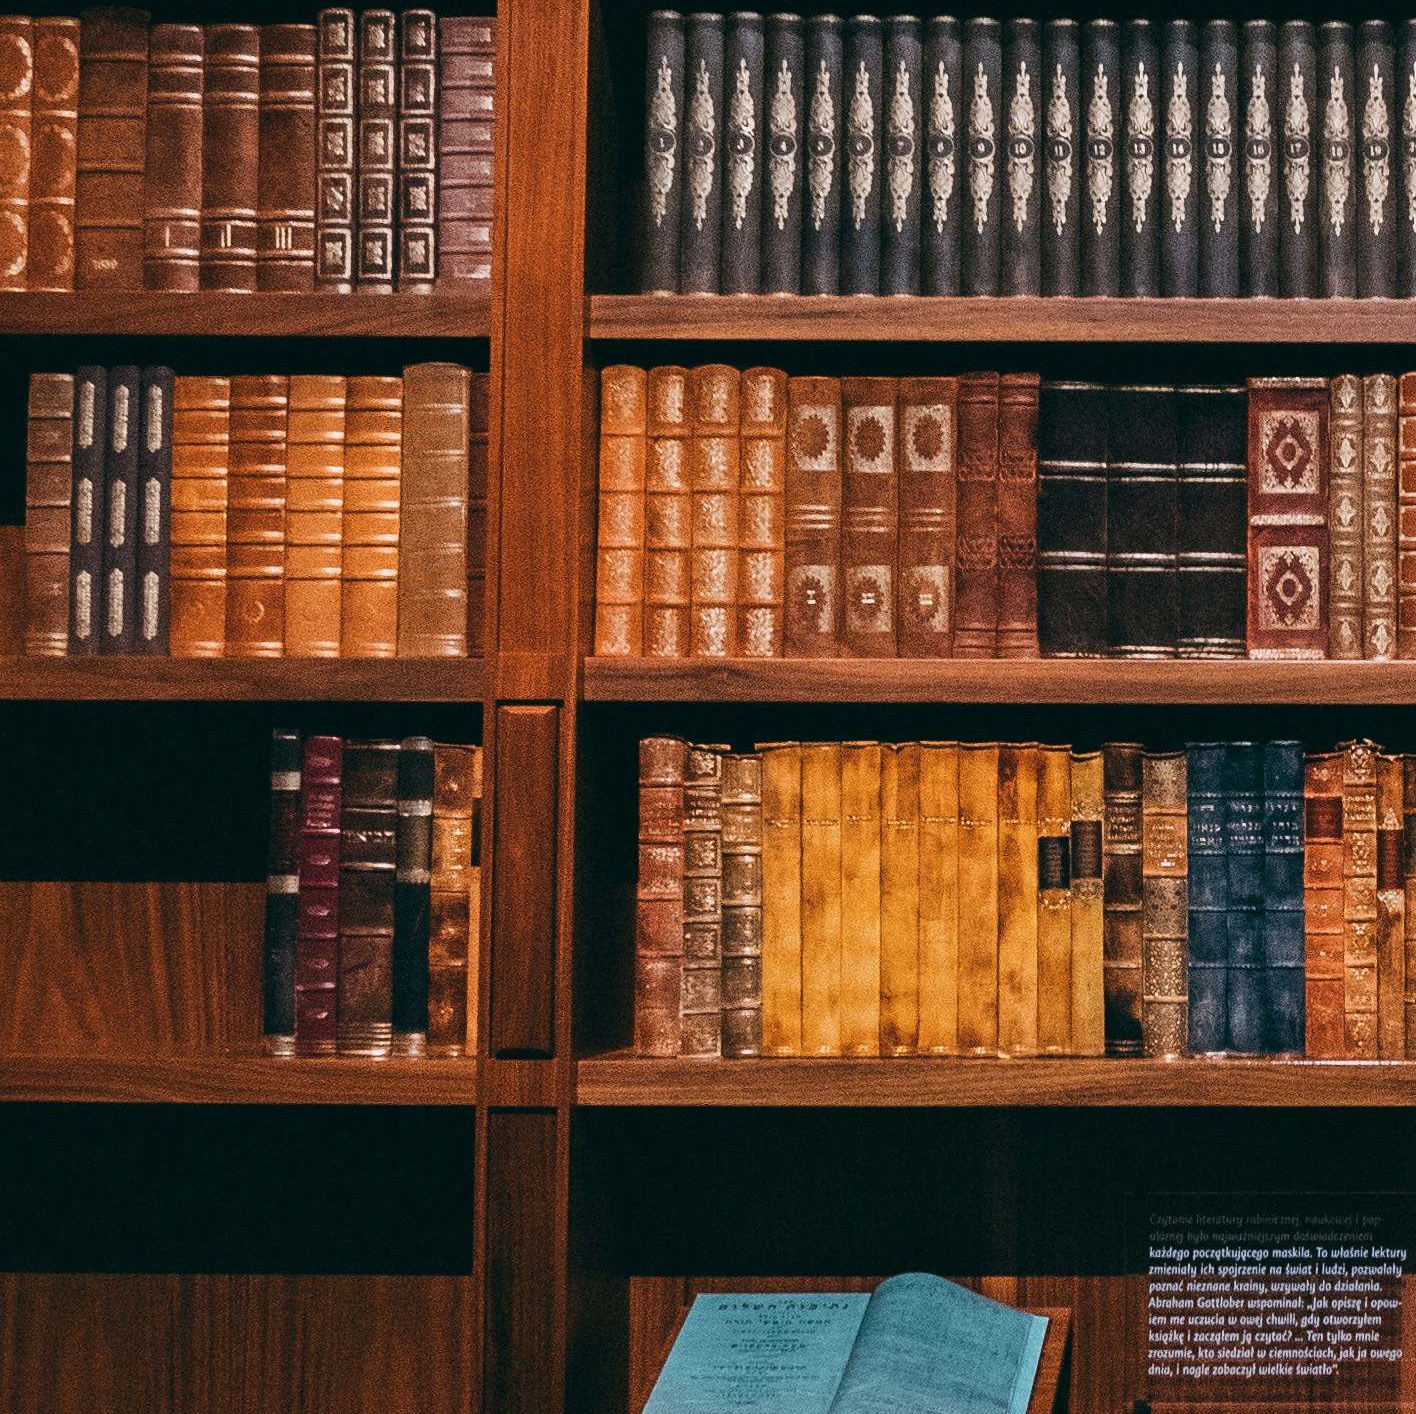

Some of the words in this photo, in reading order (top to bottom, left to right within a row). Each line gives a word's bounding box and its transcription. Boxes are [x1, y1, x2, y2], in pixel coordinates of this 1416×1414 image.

[1148, 1246, 1190, 1261] każdego
[1271, 1246, 1313, 1259] maskila.
[1315, 1246, 1329, 1259] To
[1330, 1246, 1369, 1259] właśnie
[1371, 1245, 1408, 1262] lektury
[1148, 1263, 1198, 1278] zmieniały
[1200, 1263, 1215, 1275] ich
[1217, 1264, 1267, 1278] spojrzenie
[1269, 1265, 1283, 1276] na
[1285, 1263, 1313, 1276] świat
[1321, 1262, 1349, 1277] ludzi,
[1351, 1263, 1403, 1279] pozwalały
[1148, 1281, 1184, 1295] poznać
[1186, 1282, 1231, 1292] nieznane
[1233, 1280, 1269, 1295] krainy,
[1270, 1279, 1316, 1295] wzywały
[1318, 1279, 1332, 1292] do
[1333, 1280, 1383, 1292] działania.
[1147, 1296, 1195, 1309] Abraham
[1196, 1296, 1245, 1309] Gottlober
[1247, 1296, 1304, 1311] wspominał:
[1306, 1296, 1329, 1312] „Jak
[1331, 1299, 1362, 1312] opiszę
[1370, 1298, 1403, 1311] opow-
